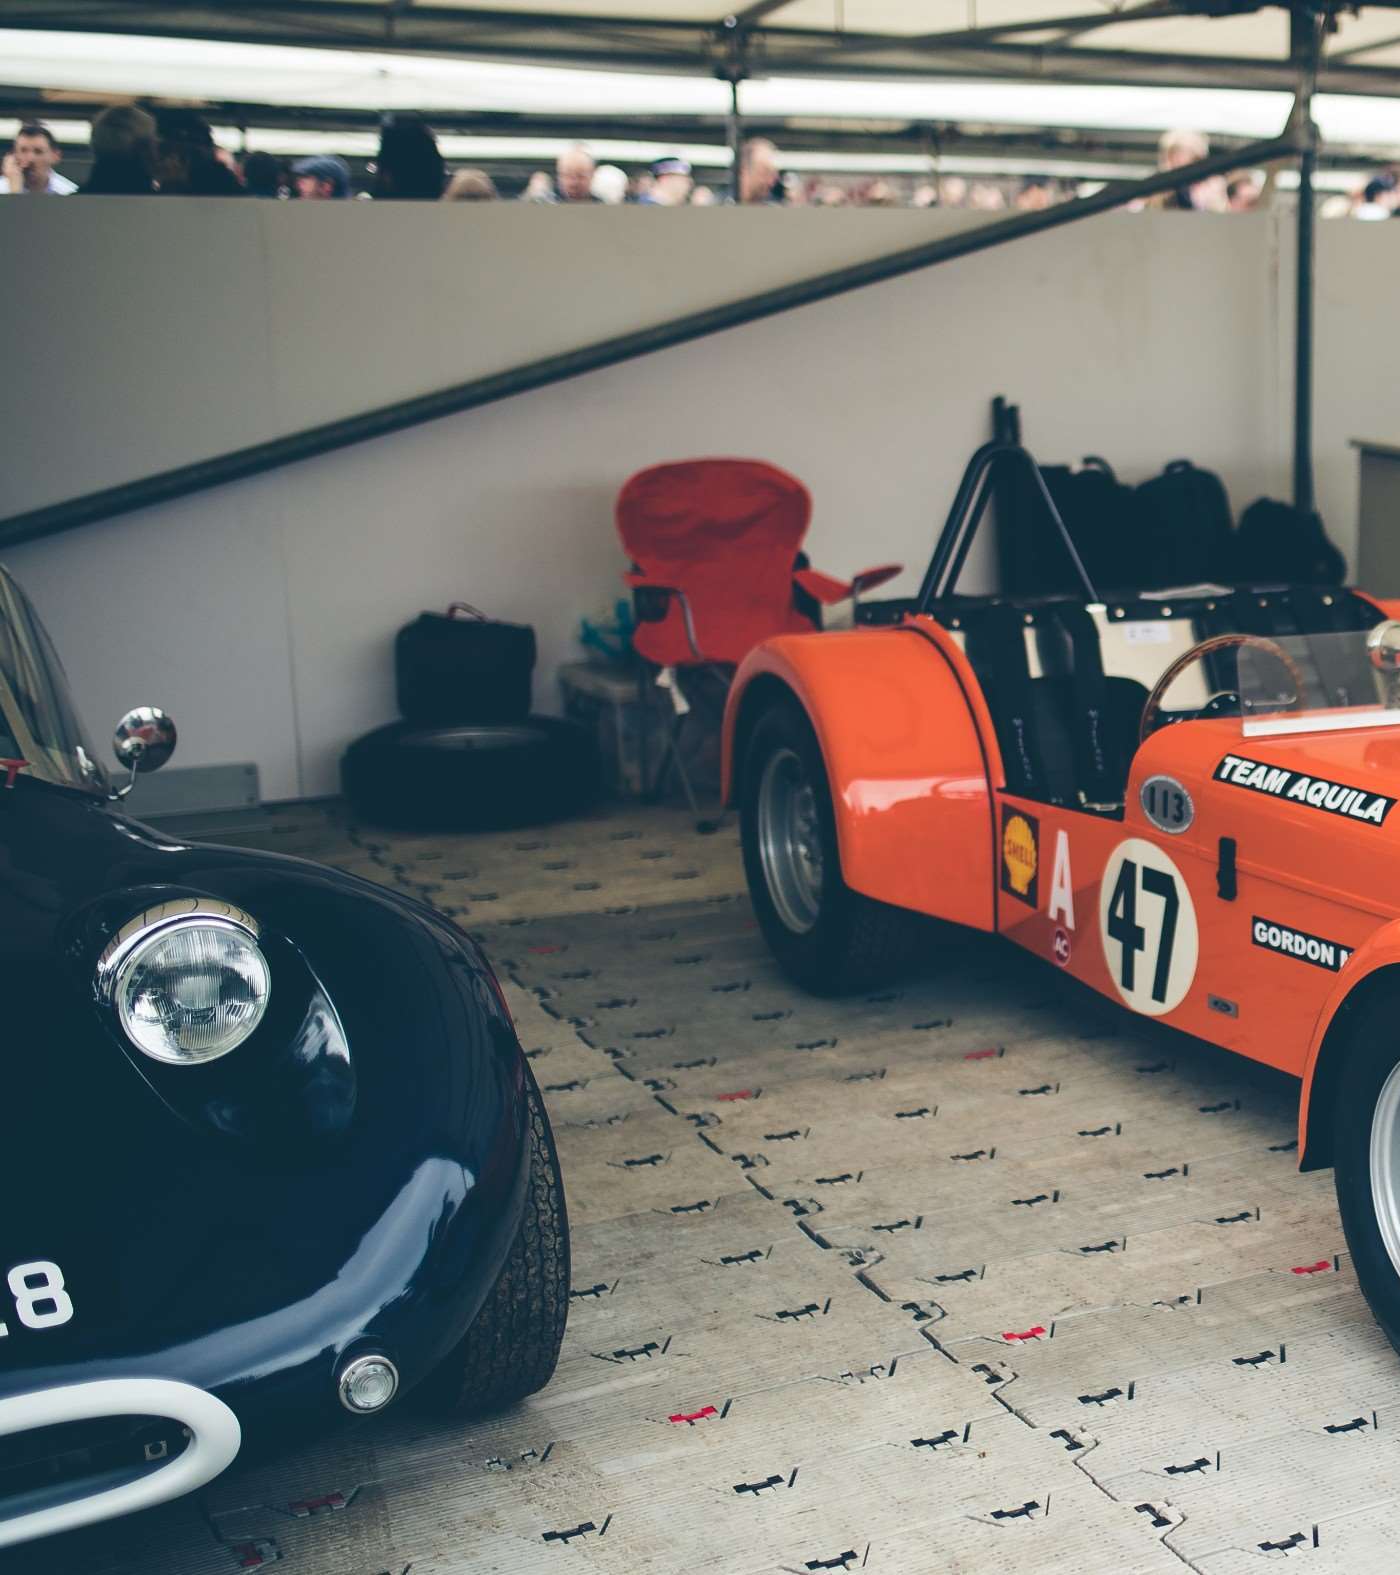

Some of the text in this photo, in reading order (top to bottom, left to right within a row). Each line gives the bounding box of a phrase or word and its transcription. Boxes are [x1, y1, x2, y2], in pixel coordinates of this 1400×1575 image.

[1149, 784, 1184, 823] 113
[1219, 755, 1387, 823] TEAM AQUILA
[1007, 839, 1033, 869] SHELL
[1048, 829, 1075, 931] A
[1107, 858, 1180, 1003] 47
[1254, 922, 1335, 967] GORDON
[0, 1260, 74, 1337] 8
